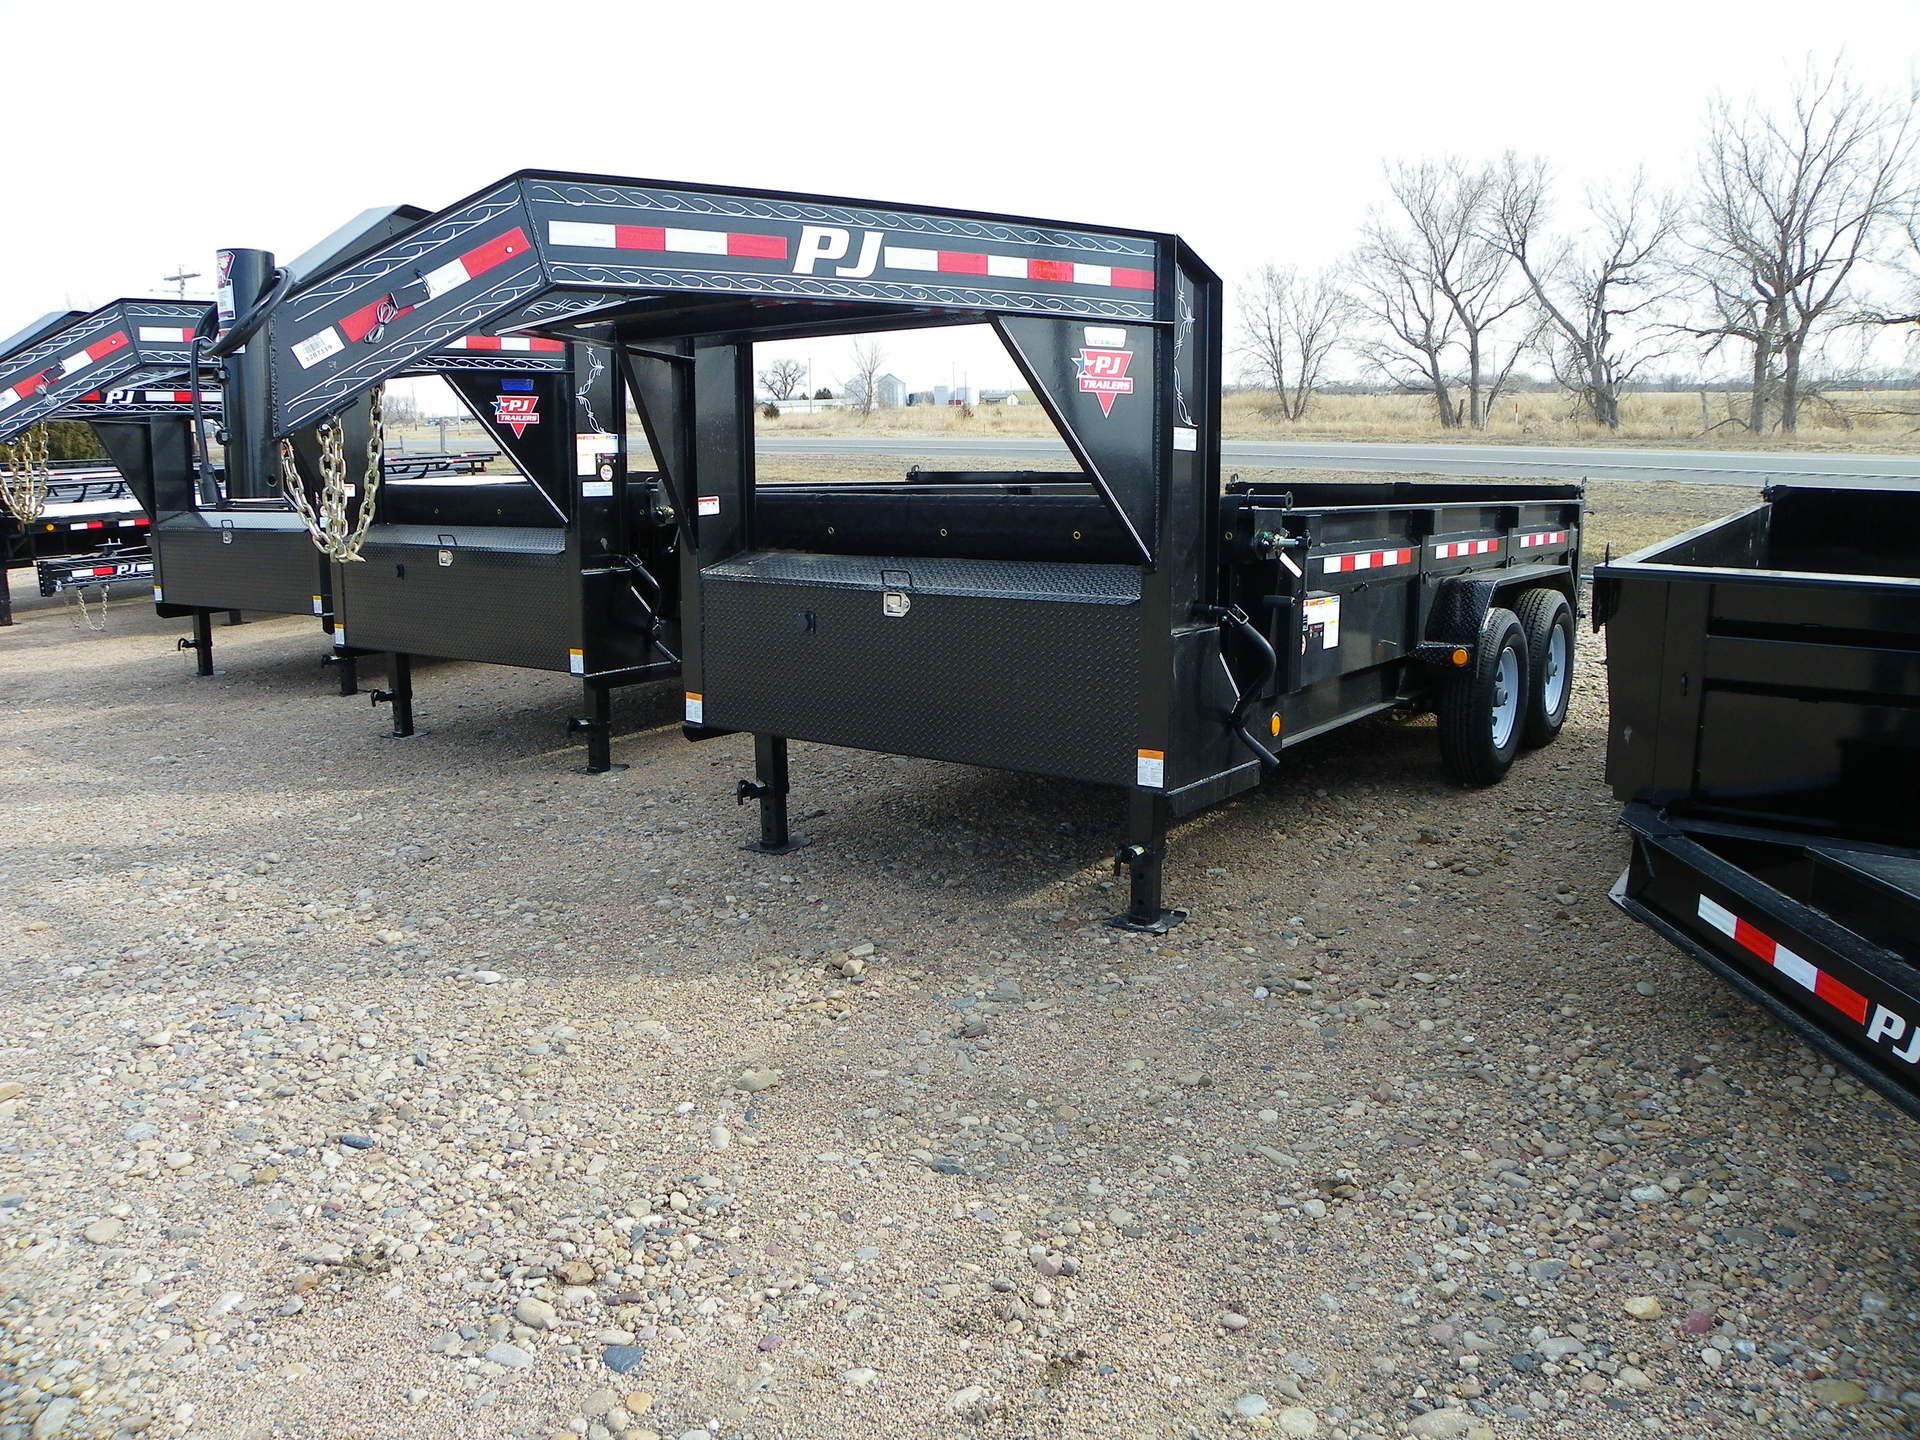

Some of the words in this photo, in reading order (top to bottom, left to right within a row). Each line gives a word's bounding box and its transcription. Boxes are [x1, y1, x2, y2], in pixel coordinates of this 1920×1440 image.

[792, 225, 884, 278] PJ
[1094, 355, 1121, 375] PJ
[1083, 380, 1131, 391] TRAILERS
[105, 389, 135, 404] PJ
[508, 399, 530, 412] PJ
[116, 563, 137, 576] PJ
[1866, 1003, 1920, 1064] PJ
